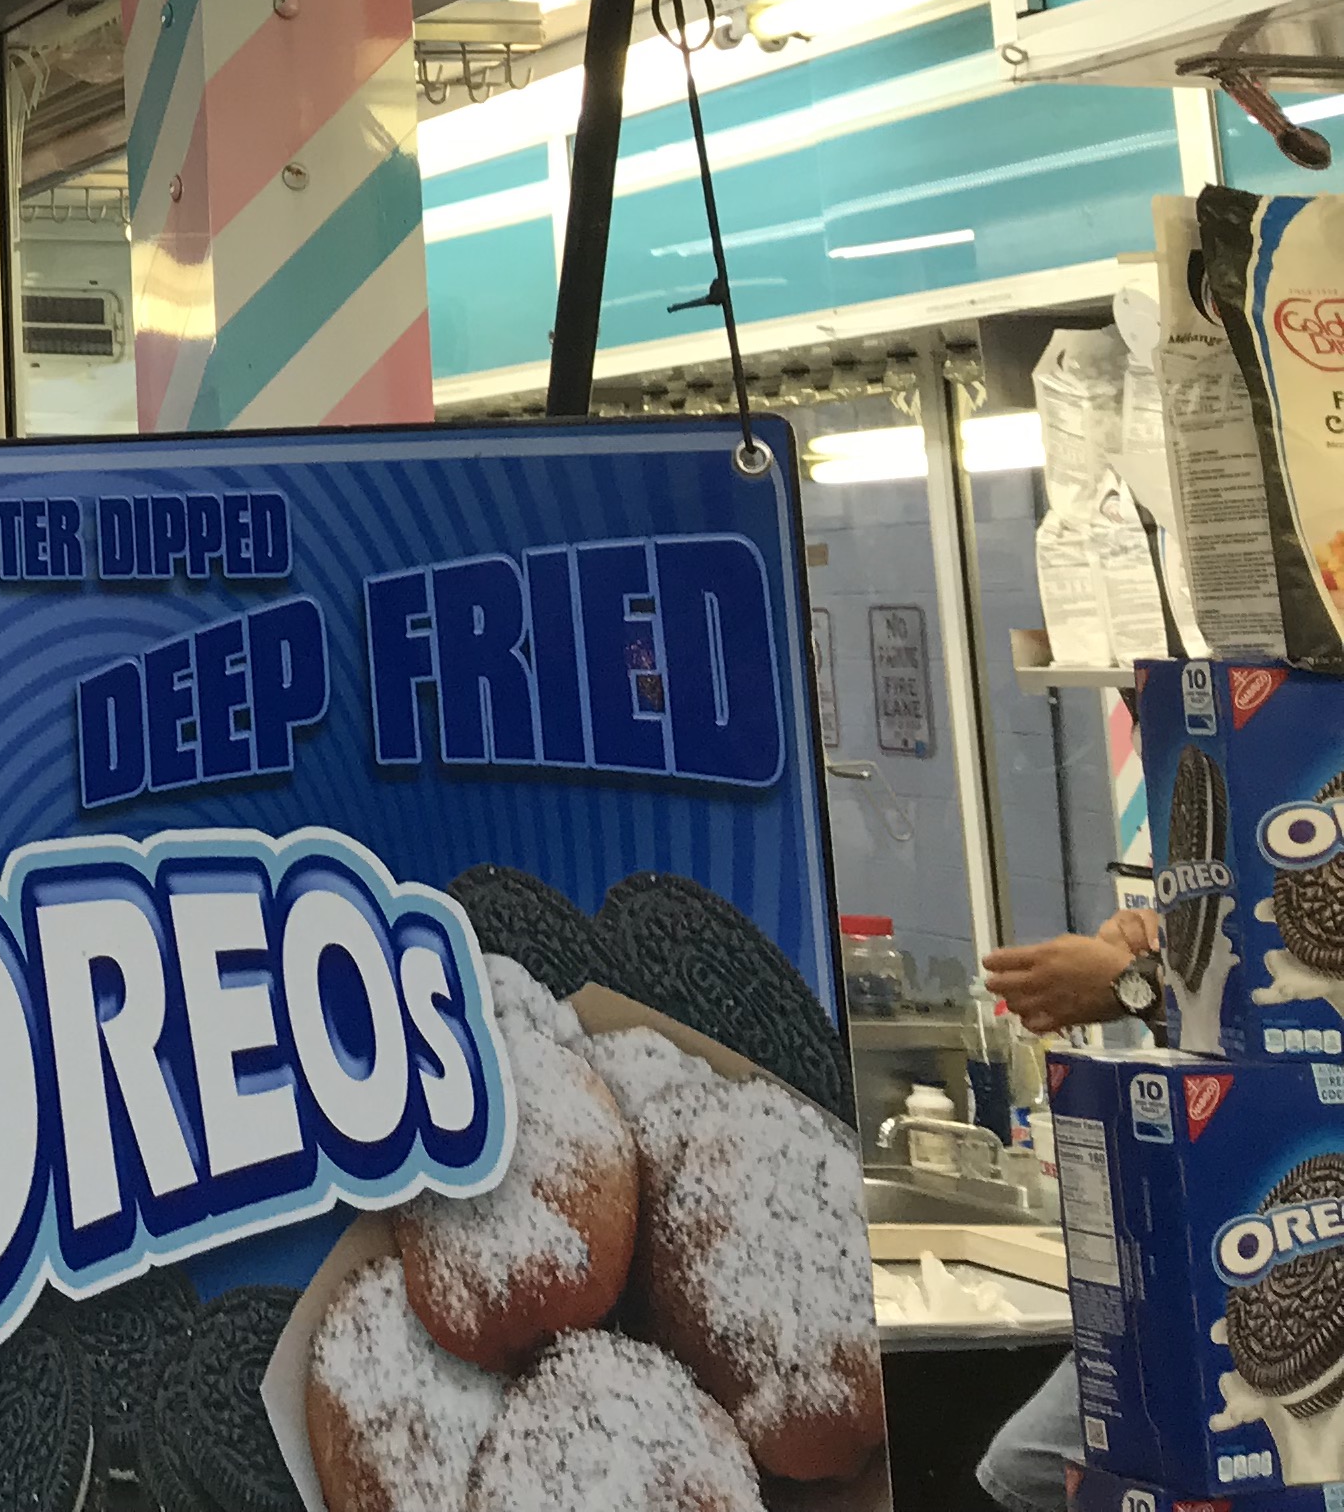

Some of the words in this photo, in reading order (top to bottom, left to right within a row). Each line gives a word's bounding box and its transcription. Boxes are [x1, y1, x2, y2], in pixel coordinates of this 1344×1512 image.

[95, 491, 294, 580] DIPPED
[77, 596, 330, 810] DEEP
[363, 532, 787, 788] FRIED
[1186, 668, 1207, 690] 10
[1157, 862, 1231, 905] OREO
[1136, 1080, 1164, 1101] 10
